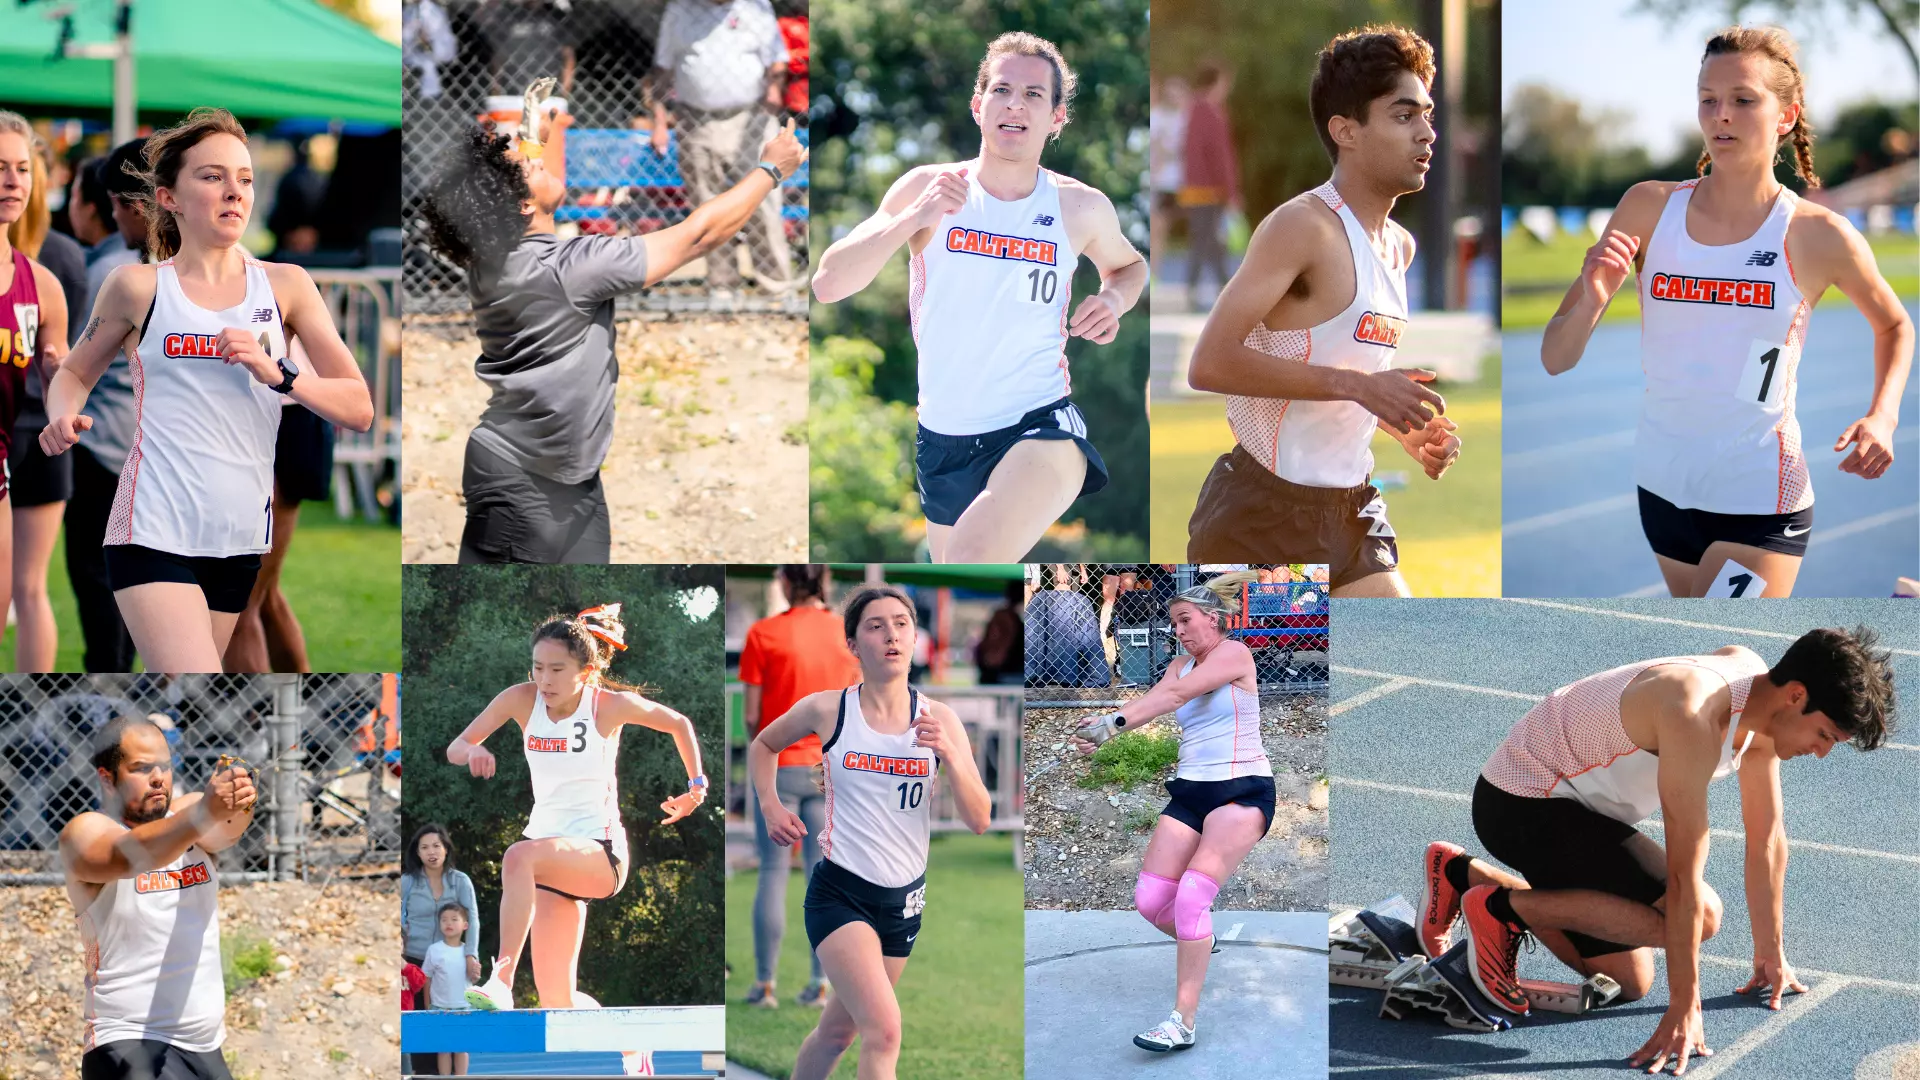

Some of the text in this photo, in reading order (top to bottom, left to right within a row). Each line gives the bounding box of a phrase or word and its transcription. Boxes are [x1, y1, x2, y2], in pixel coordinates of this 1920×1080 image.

[946, 226, 1058, 267] CALTECH
[1027, 268, 1058, 305] 10
[1650, 271, 1776, 310] CALTECH
[25, 308, 36, 353] 6
[1759, 346, 1781, 403] 1
[1728, 573, 1753, 598] 1
[527, 734, 568, 753] CALTE
[571, 721, 588, 753] 3
[842, 750, 930, 777] CALTECH
[897, 781, 924, 810] 10
[1428, 850, 1444, 925] new balance
